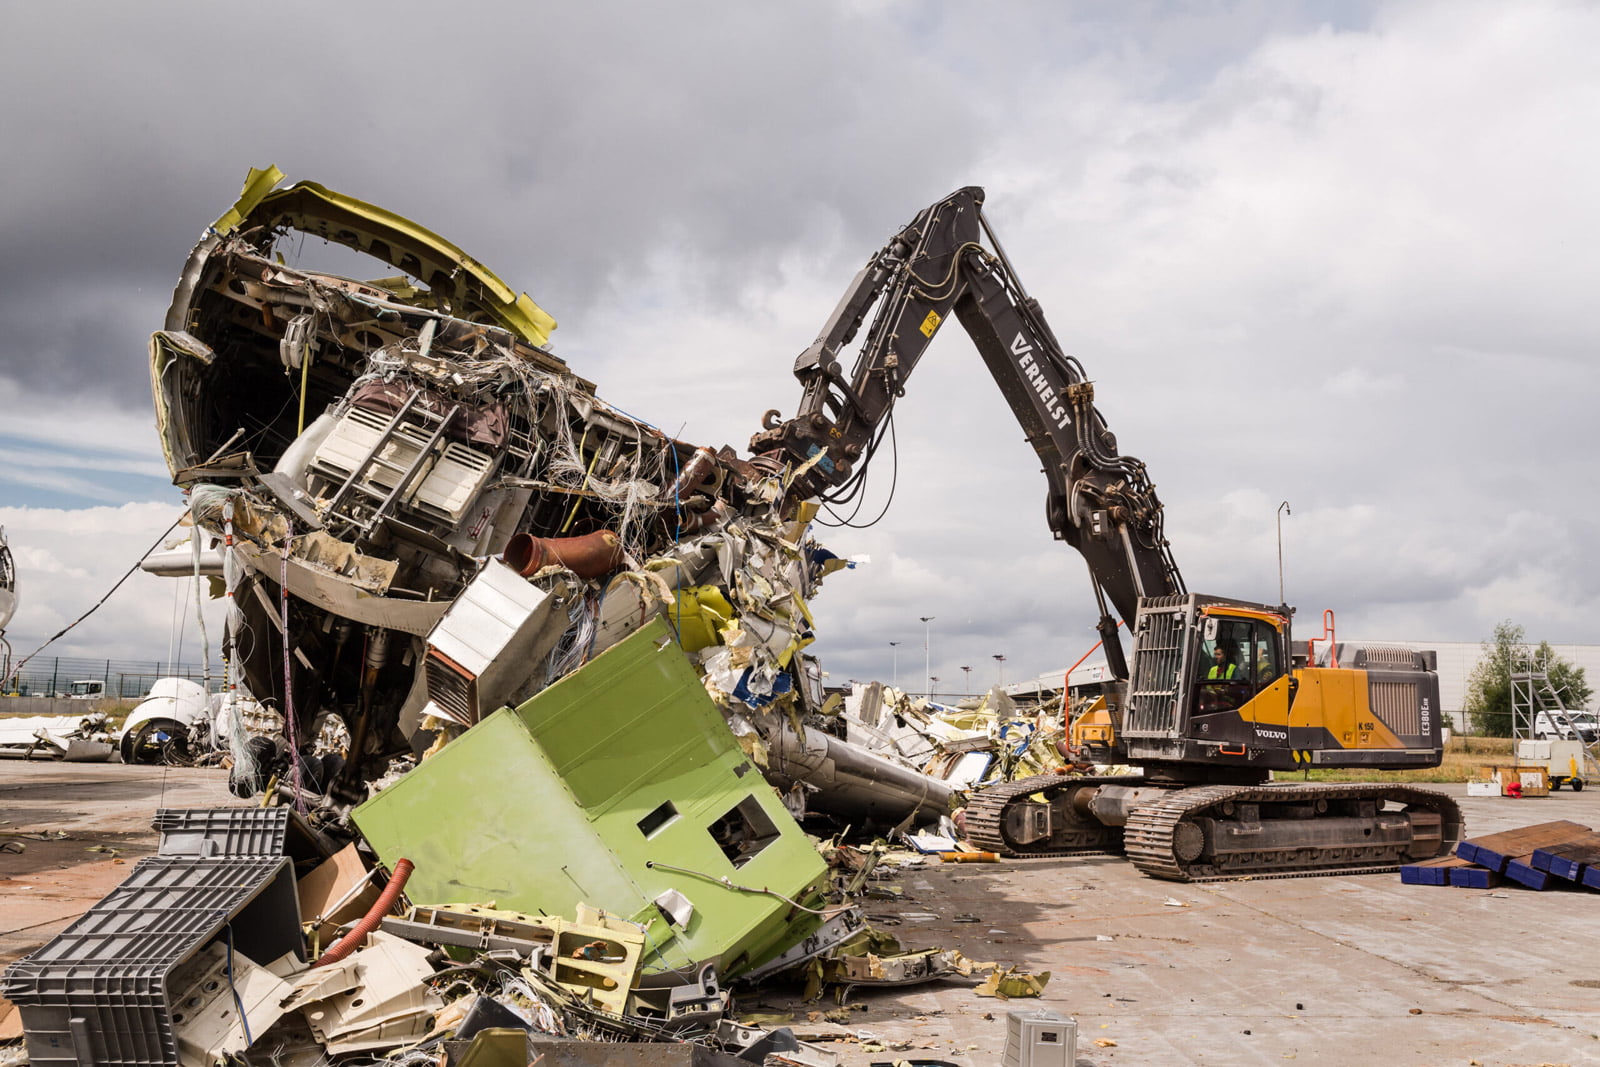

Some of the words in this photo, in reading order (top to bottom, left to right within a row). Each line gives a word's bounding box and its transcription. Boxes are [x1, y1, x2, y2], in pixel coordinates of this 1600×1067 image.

[1010, 331, 1072, 430] VERHELST
[1358, 722, 1363, 731] K
[1364, 722, 1375, 731] 150
[1255, 729, 1287, 740] VOLVO
